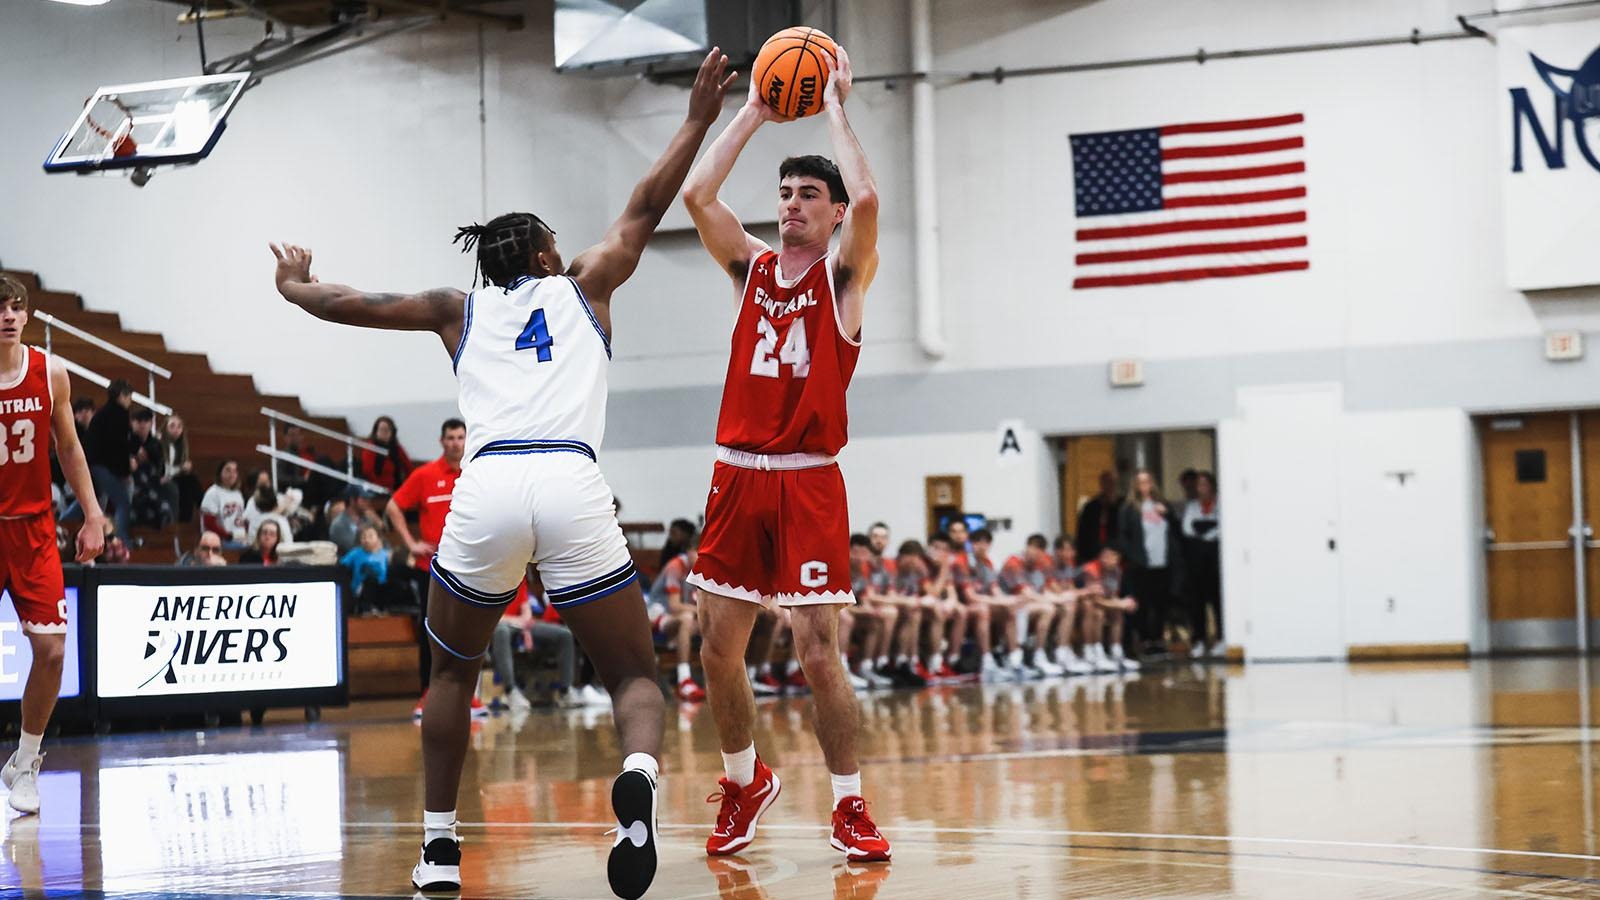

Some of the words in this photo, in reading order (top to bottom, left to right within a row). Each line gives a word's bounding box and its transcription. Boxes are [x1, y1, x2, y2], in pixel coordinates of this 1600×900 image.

[515, 307, 554, 363] 4
[750, 315, 812, 379] 24
[1000, 428, 1021, 454] A
[800, 560, 828, 588] C
[150, 595, 297, 621] AMERICAN
